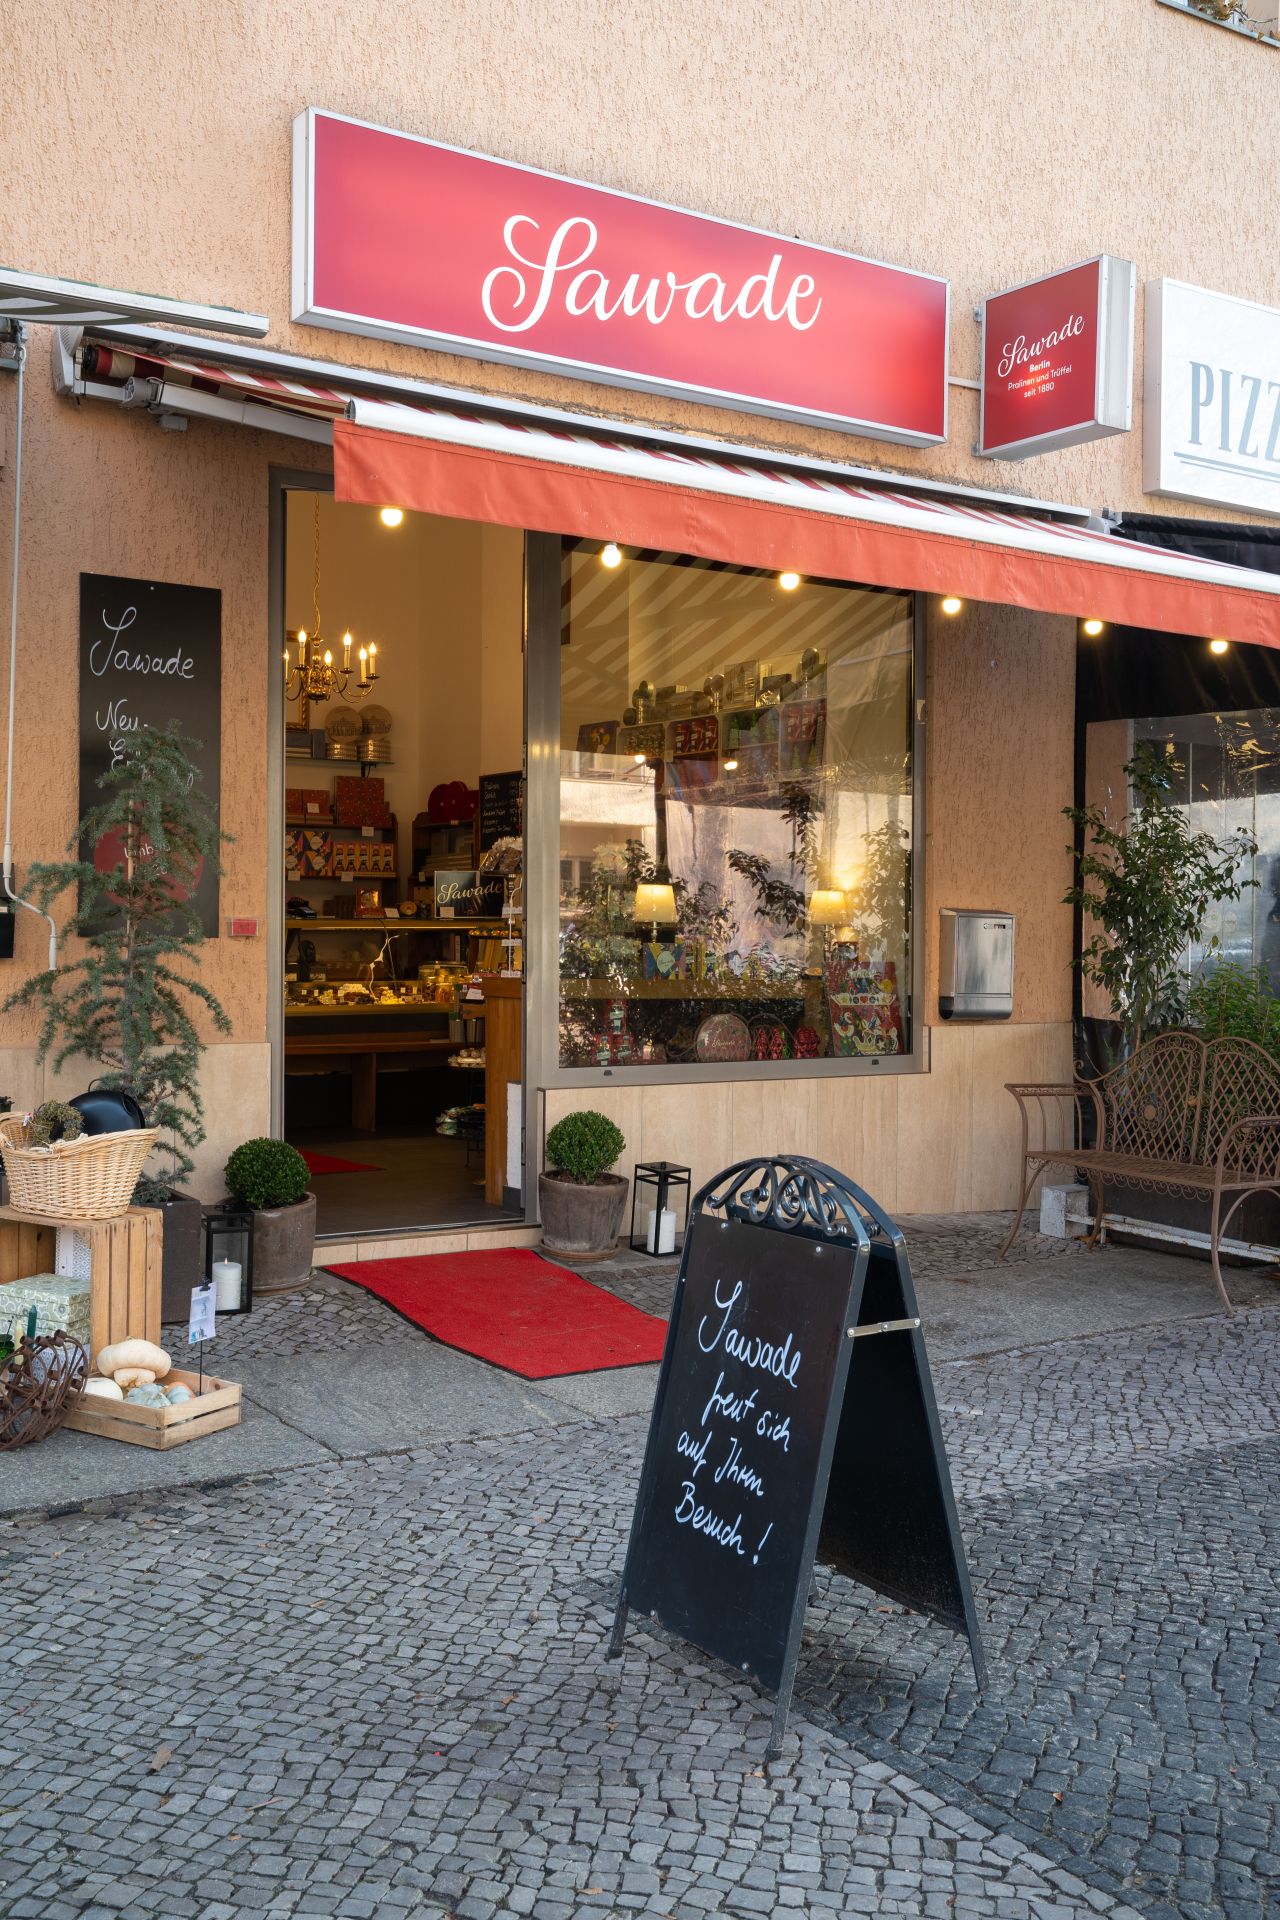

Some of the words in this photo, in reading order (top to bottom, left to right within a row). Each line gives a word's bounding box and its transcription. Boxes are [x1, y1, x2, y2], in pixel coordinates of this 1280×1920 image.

[481, 214, 822, 332] Sawade
[997, 314, 1085, 378] Sawade
[1007, 377, 1035, 391] Pralinen
[1036, 372, 1049, 383] und
[1050, 364, 1072, 379] Trüffel
[1029, 360, 1051, 373] Berlin
[1023, 387, 1036, 398] seit
[1037, 382, 1055, 394] 1880
[90, 606, 195, 679] Sawade
[698, 1279, 801, 1388] Sawade
[701, 1371, 759, 1427] freut
[756, 1410, 791, 1452] sich
[677, 1430, 712, 1478] auf
